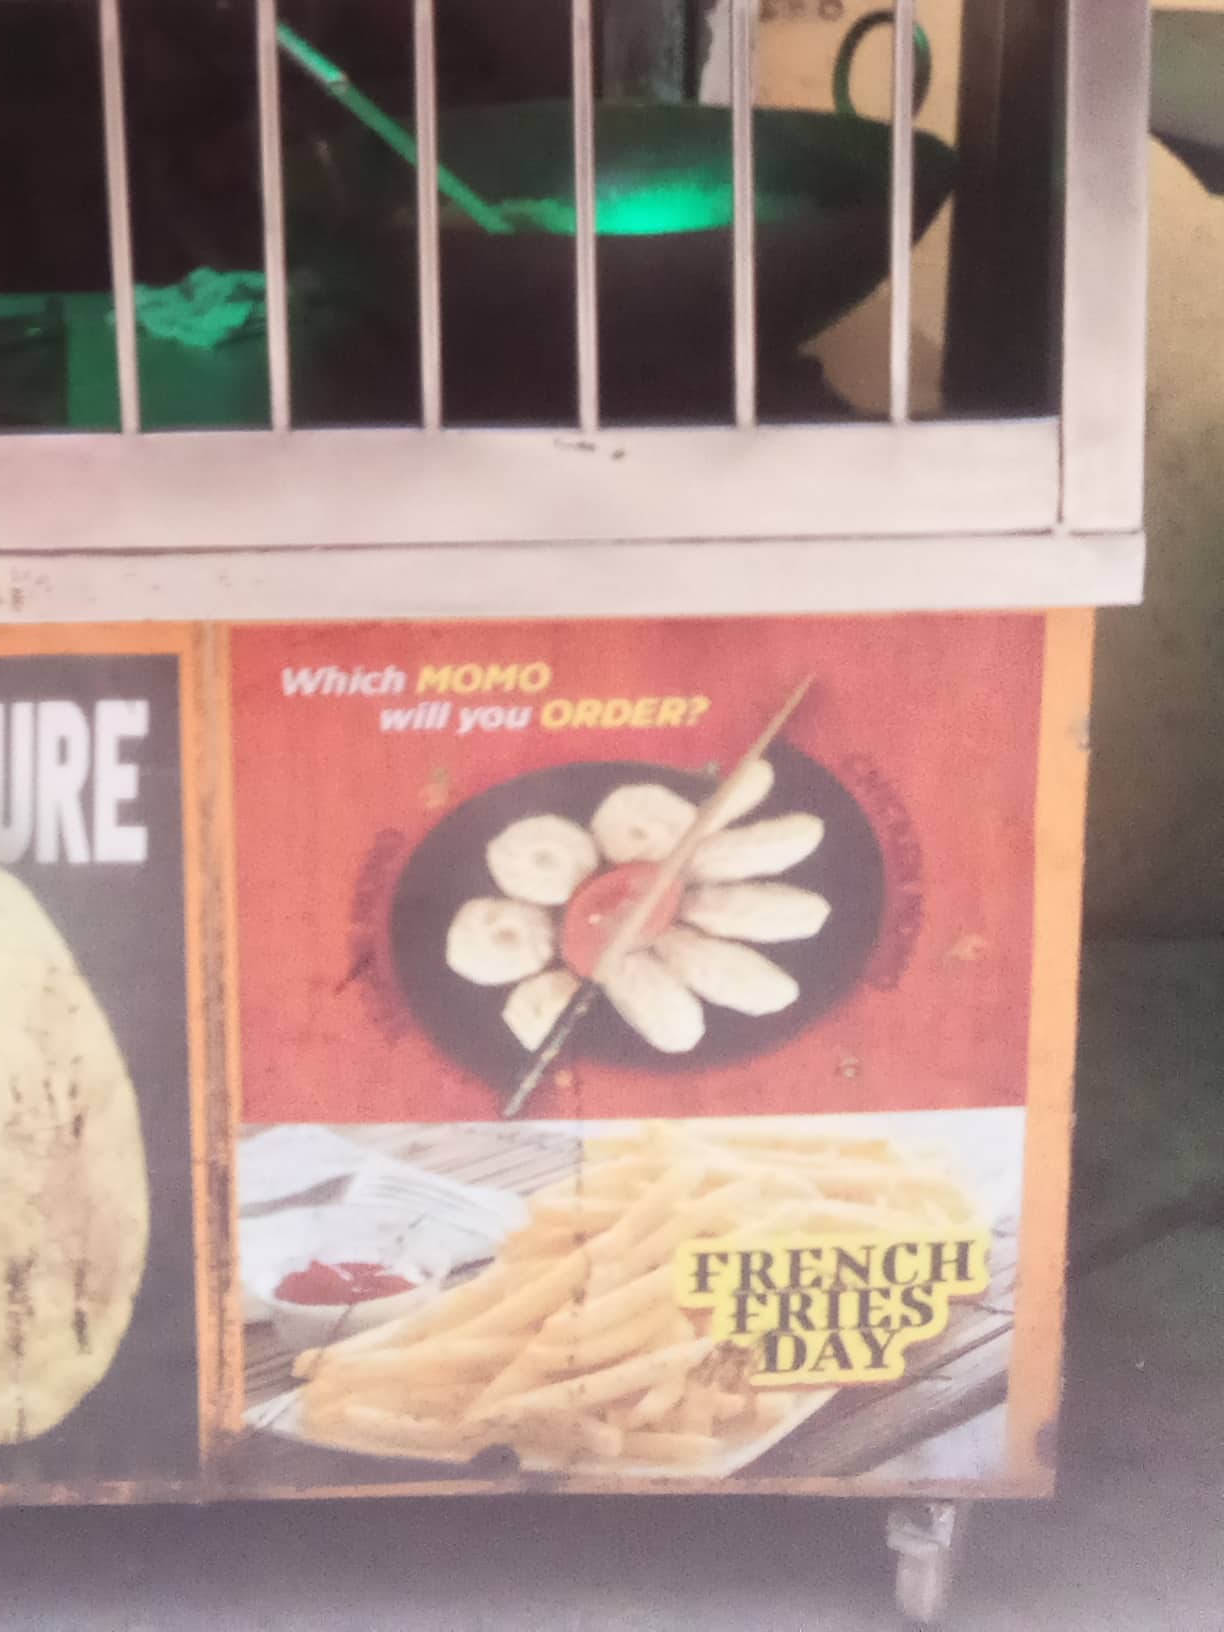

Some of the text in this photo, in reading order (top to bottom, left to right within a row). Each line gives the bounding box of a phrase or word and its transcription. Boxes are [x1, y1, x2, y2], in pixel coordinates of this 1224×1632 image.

[281, 661, 552, 696] Which MOMO
[380, 695, 712, 735] will you ORDER?
[688, 1240, 976, 1295] FRENCH
[729, 1283, 935, 1335] FRIES
[762, 1328, 902, 1375] DAY
